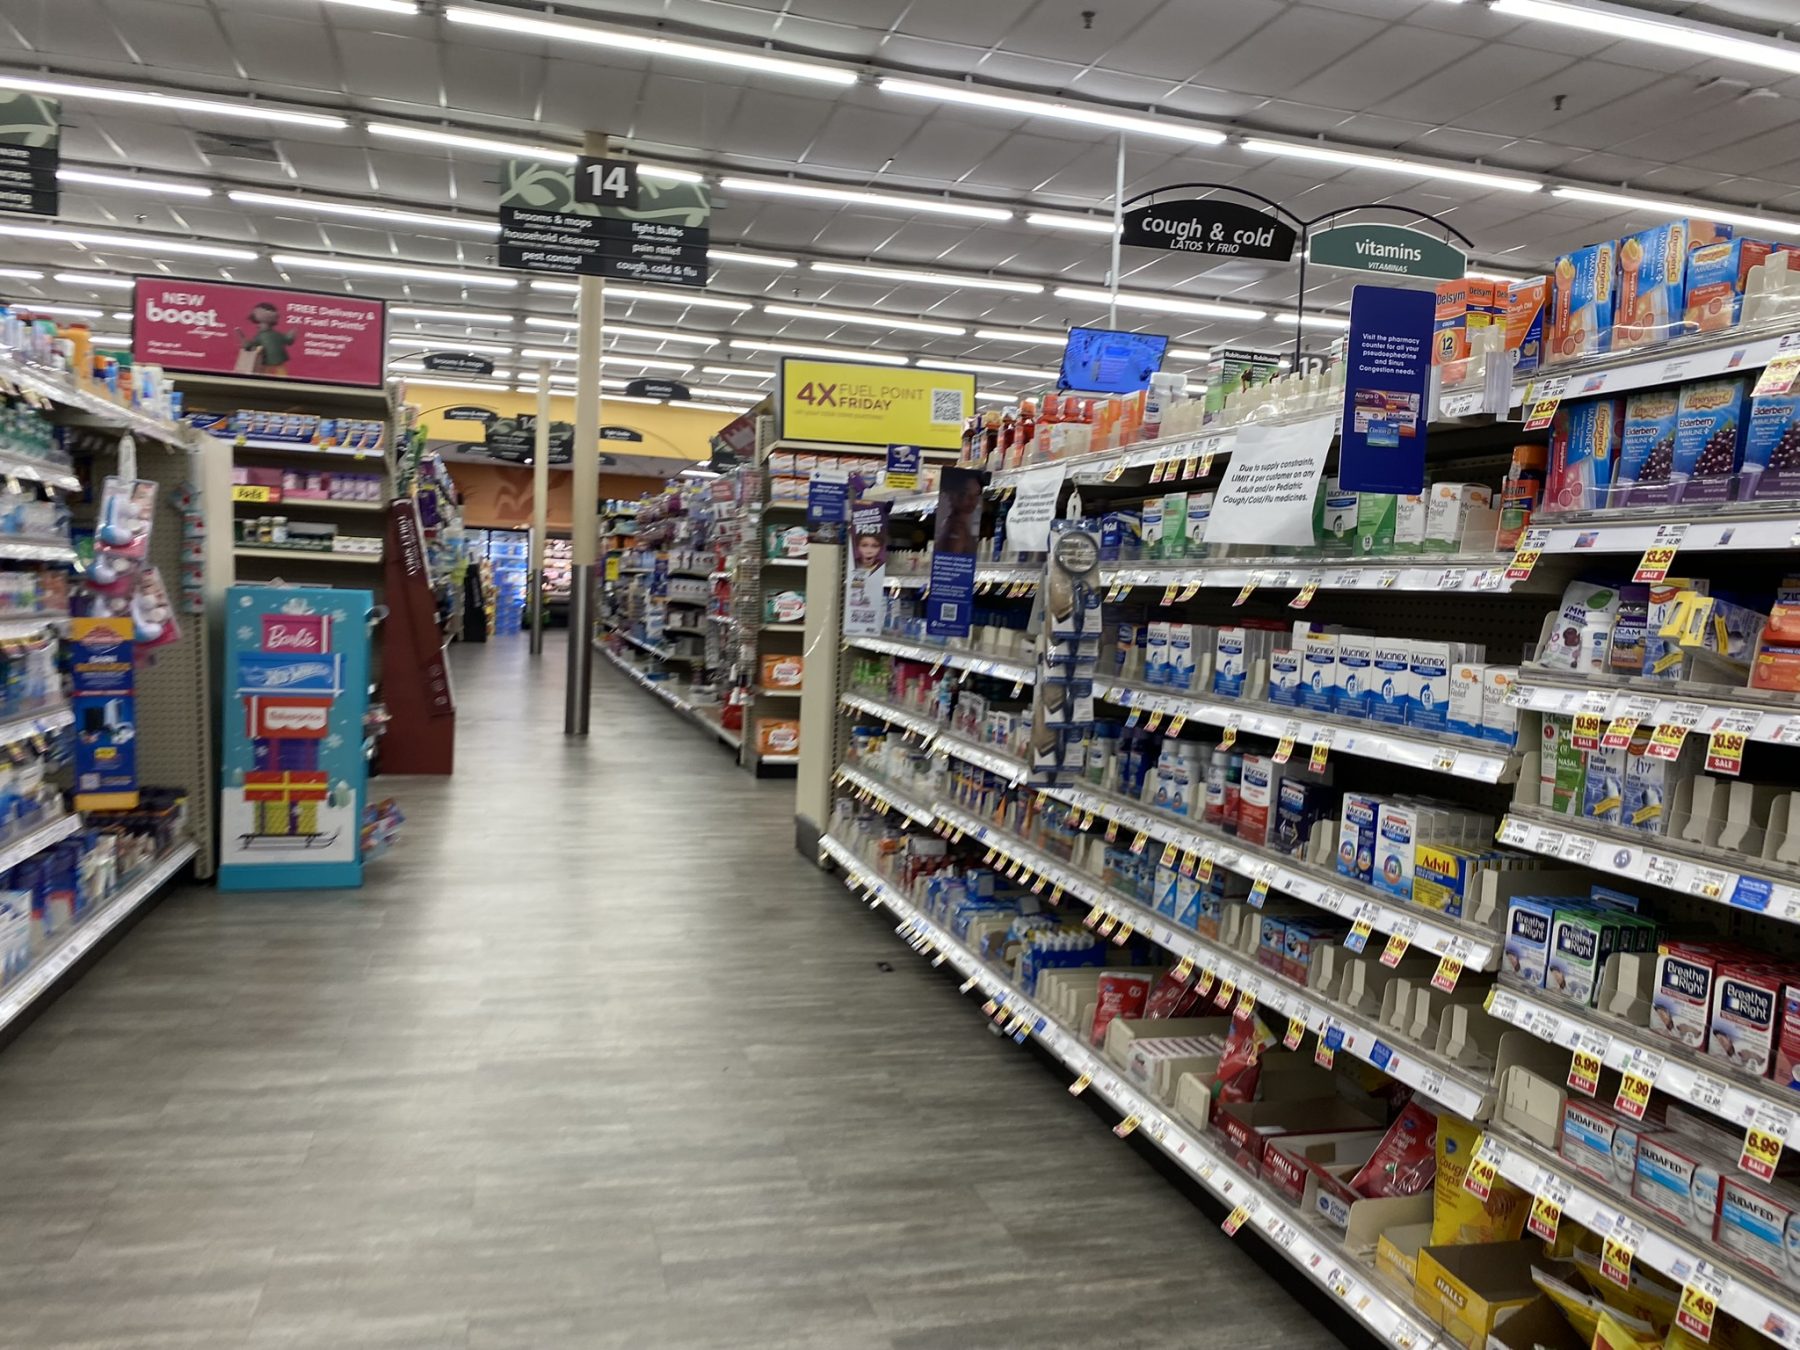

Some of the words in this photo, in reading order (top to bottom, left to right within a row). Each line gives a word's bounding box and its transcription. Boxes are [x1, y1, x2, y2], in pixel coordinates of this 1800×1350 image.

[586, 164, 630, 199] 14
[513, 210, 553, 224] brooms
[554, 214, 563, 224] &
[564, 215, 593, 229] mops
[632, 221, 656, 236] light
[656, 226, 685, 238] bulbs
[1141, 213, 1203, 241] cough
[1210, 222, 1225, 242] &
[1233, 225, 1275, 248] cold
[503, 229, 557, 243] household
[558, 233, 601, 247] cleaners
[1169, 238, 1203, 252] LATOS
[1205, 241, 1214, 251] Y
[1216, 242, 1240, 254] FRIO
[521, 251, 545, 264] pest
[546, 253, 583, 265] control
[632, 243, 654, 256] pain
[655, 244, 682, 257] relief
[1355, 238, 1423, 262] vitamins
[616, 260, 650, 275] cough,
[651, 263, 673, 275] cold
[673, 266, 683, 275] &
[684, 267, 698, 277] flu
[1367, 260, 1409, 274] VITAMINAS
[162, 291, 206, 307] NEW
[1436, 290, 1466, 306] Delsym
[1469, 286, 1492, 297] Delsym
[145, 298, 217, 328] boost
[286, 303, 319, 315] FREE
[318, 307, 366, 320] Delivery
[366, 311, 375, 321] &
[285, 314, 303, 324] 2X
[303, 316, 330, 327] Fuel
[1361, 341, 1386, 350] counter
[1386, 342, 1395, 350] for
[1396, 343, 1405, 351] all
[1405, 345, 1420, 353] your
[1362, 333, 1377, 341] Visit
[1387, 335, 1420, 345] pharmacy
[1442, 336, 1453, 351] 12
[1362, 350, 1417, 361] pseudoephedrine
[1388, 359, 1404, 367] Sinus
[1358, 365, 1395, 374] Congestion
[1394, 367, 1416, 376] needs.
[797, 381, 838, 407] 4X
[839, 383, 877, 398] FUEL
[880, 386, 926, 401] POINT
[838, 397, 893, 411] FRIDAY
[1753, 405, 1795, 416] Elderberry
[1679, 416, 1716, 428] Elderberry
[1625, 426, 1660, 436] Elderberry
[1239, 464, 1252, 472] Due
[1254, 463, 1260, 471] to
[1261, 461, 1279, 472] supply
[1280, 457, 1314, 469] constraints,
[1231, 474, 1249, 482] LIMIT
[1254, 474, 1265, 483] per
[1266, 472, 1292, 481] customer
[1303, 470, 1315, 479] any
[1236, 485, 1254, 494] Adult
[1254, 483, 1275, 493] and/or
[1276, 482, 1303, 491] Pediatric
[1274, 493, 1308, 503] medicines.
[1515, 552, 1539, 564] 13.29
[1644, 550, 1674, 564] 13.29
[1640, 571, 1658, 579] SALE
[267, 624, 319, 648] Barbie
[1306, 644, 1336, 656] Mucinex
[1340, 646, 1371, 659] Mucinex
[1375, 650, 1408, 662] Mucinex
[1411, 654, 1446, 668] Mucinex
[1451, 679, 1471, 690] Mucus
[1484, 685, 1504, 696] Mucus
[1450, 688, 1467, 698] Relief
[1575, 715, 1599, 731] 10.99
[1657, 722, 1688, 740] 10.99
[1578, 737, 1592, 747] SALE
[1608, 737, 1624, 745] SALE
[1712, 731, 1743, 751] 10.99
[1558, 757, 1578, 768] NASAL
[1714, 757, 1733, 769] SALE
[1422, 854, 1450, 873] Advil
[1515, 911, 1546, 930] Breathe
[1524, 923, 1545, 941] Right
[1561, 924, 1593, 947] Breathe
[1571, 938, 1592, 957] Right
[1667, 958, 1705, 983] Breathe
[1679, 976, 1705, 996] Right
[1726, 983, 1768, 1007] Breathe
[1739, 1000, 1767, 1021] Right
[1573, 1054, 1599, 1073] 6.99
[1575, 1076, 1590, 1090] SALE
[1623, 1075, 1649, 1097] 17.99
[1621, 1099, 1638, 1113] SALE
[1566, 1108, 1605, 1135] SUDAFED
[1228, 1123, 1247, 1143] HALLS
[1747, 1131, 1780, 1157] 6.99
[1272, 1152, 1292, 1174] HALLS
[1640, 1145, 1683, 1175] SUDAFED
[1747, 1157, 1766, 1174] SALE
[1471, 1158, 1494, 1180] 7.49
[1471, 1181, 1484, 1194] SALE
[1329, 1199, 1348, 1218] Cough
[1535, 1197, 1559, 1221] 7.49
[1726, 1190, 1774, 1222] SUDAFED
[1328, 1208, 1346, 1225] Drops
[1536, 1222, 1550, 1236] SALE
[1605, 1240, 1631, 1265] 7.49
[1387, 1248, 1412, 1274] HALLS
[1607, 1265, 1623, 1280] SALE
[1436, 1278, 1465, 1306] HALLS
[1683, 1288, 1714, 1316] 7.49
[1685, 1315, 1703, 1332] SALE
